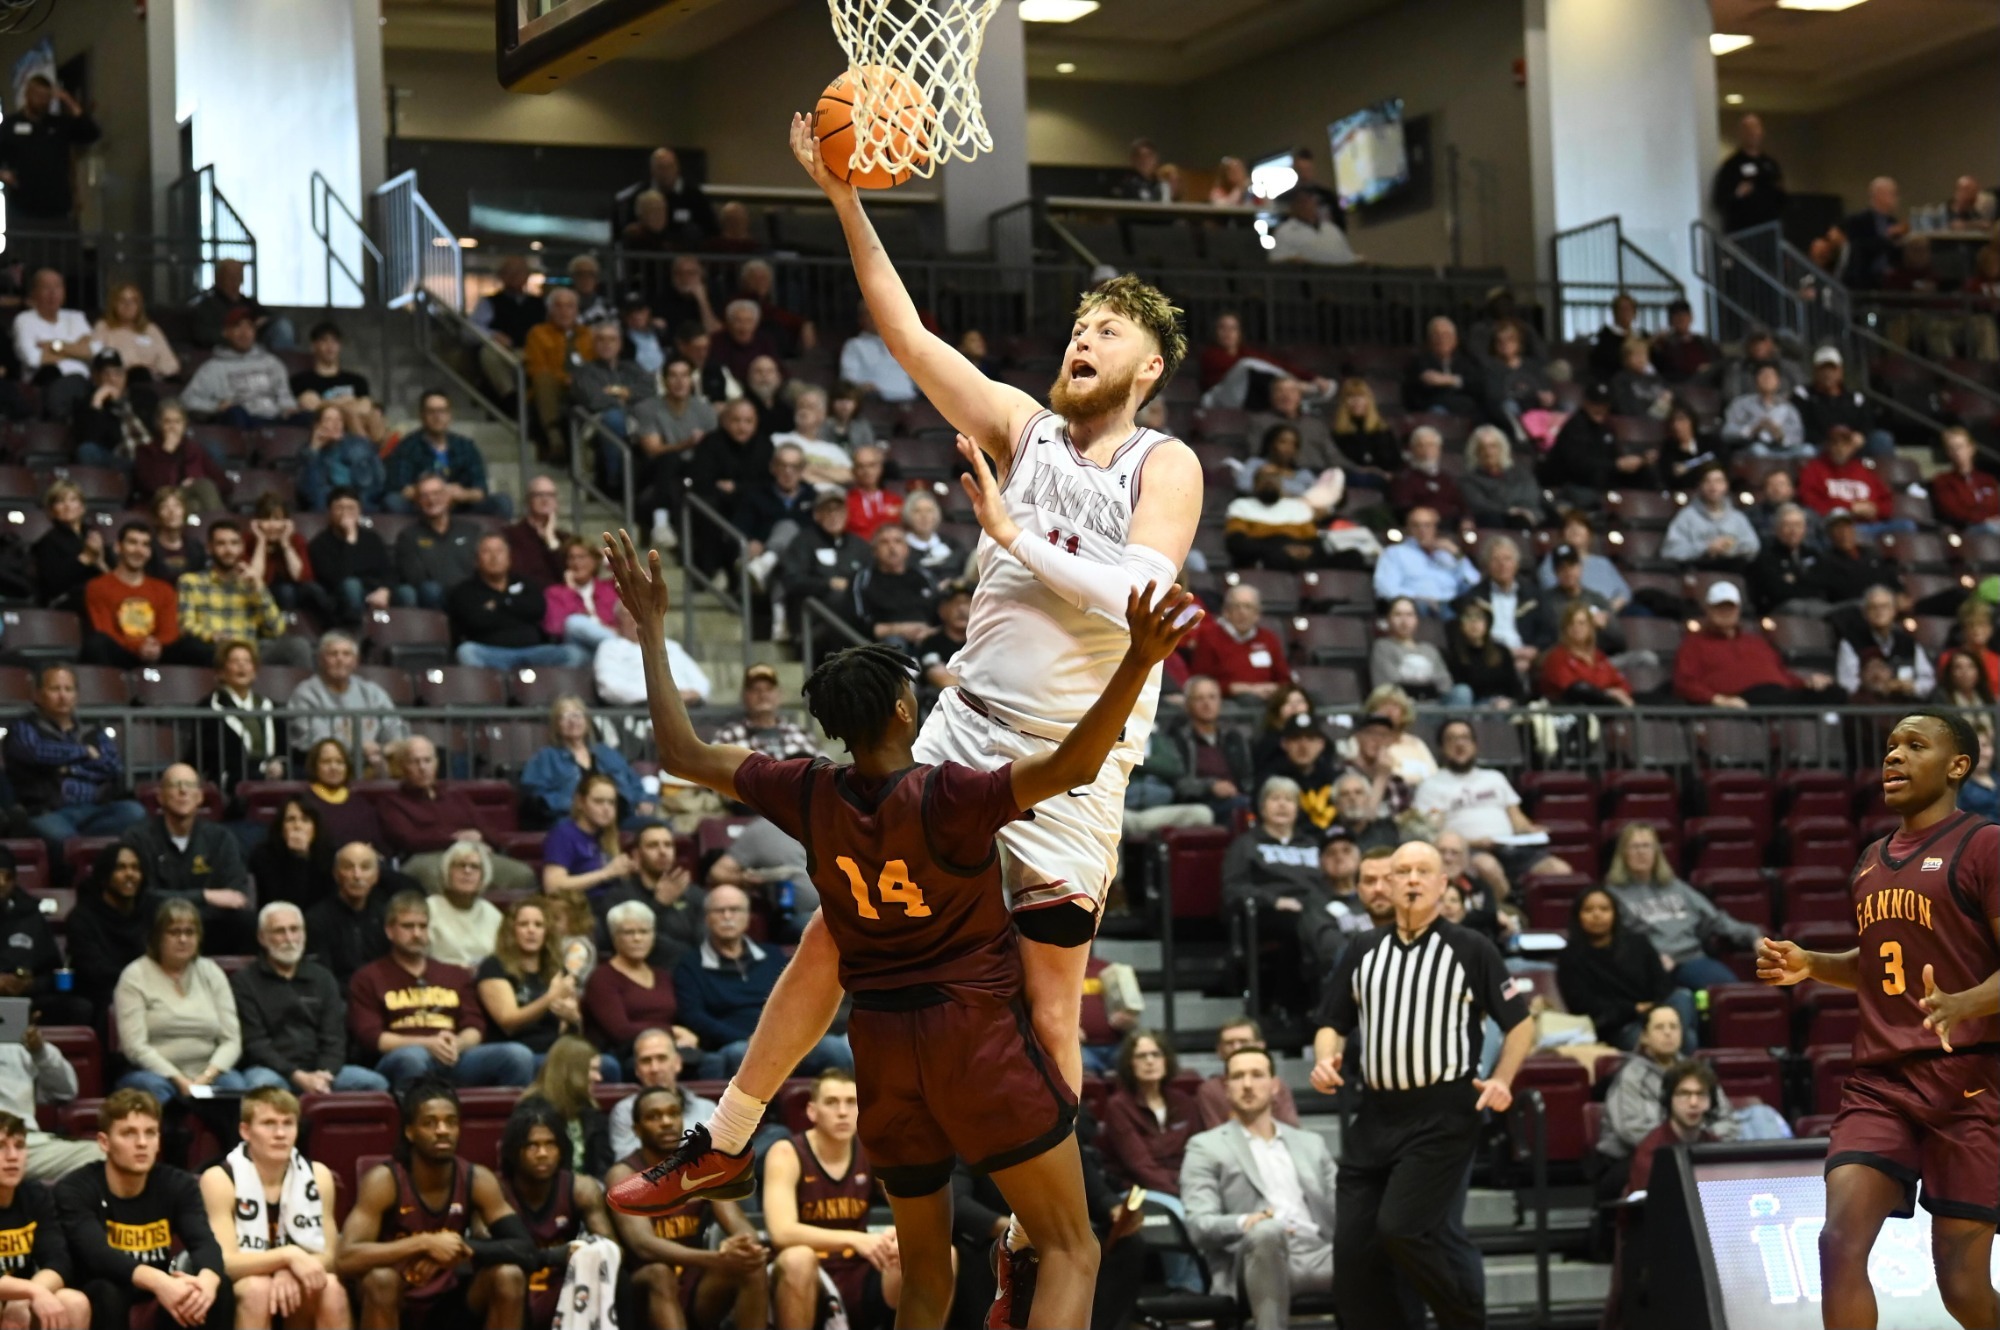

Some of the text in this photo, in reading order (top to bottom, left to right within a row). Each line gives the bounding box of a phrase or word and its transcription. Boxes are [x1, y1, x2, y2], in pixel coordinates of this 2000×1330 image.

[1023, 461, 1125, 544] HAWKS
[835, 855, 932, 920] 14
[1856, 888, 1934, 936] GANNON
[1879, 940, 1906, 996] 3
